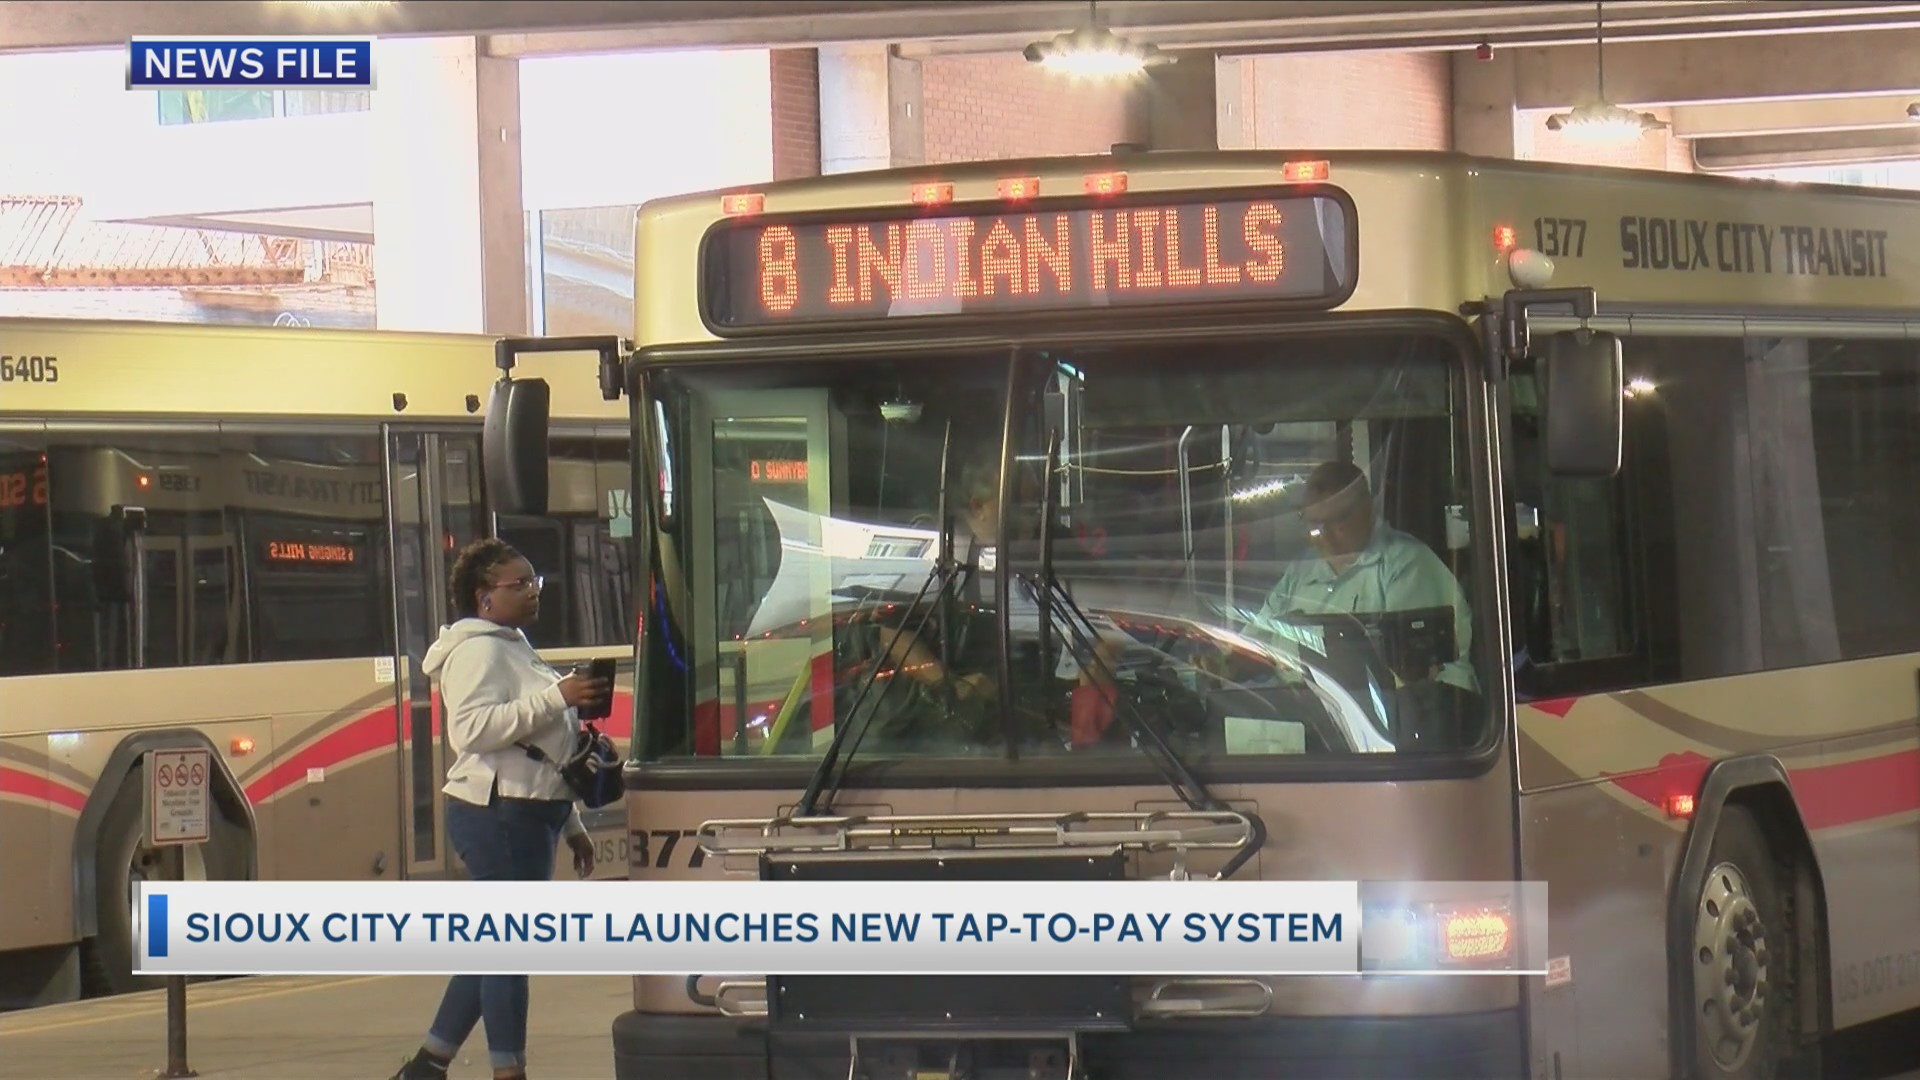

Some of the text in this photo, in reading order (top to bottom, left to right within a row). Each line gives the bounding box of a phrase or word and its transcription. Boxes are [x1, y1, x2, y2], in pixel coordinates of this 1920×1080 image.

[758, 202, 1286, 312] 8 INDIAN HILLS
[1534, 216, 1587, 257] 1377
[1620, 216, 1888, 277] SIOUX CITY TRANSIT
[0, 355, 59, 382] 6405
